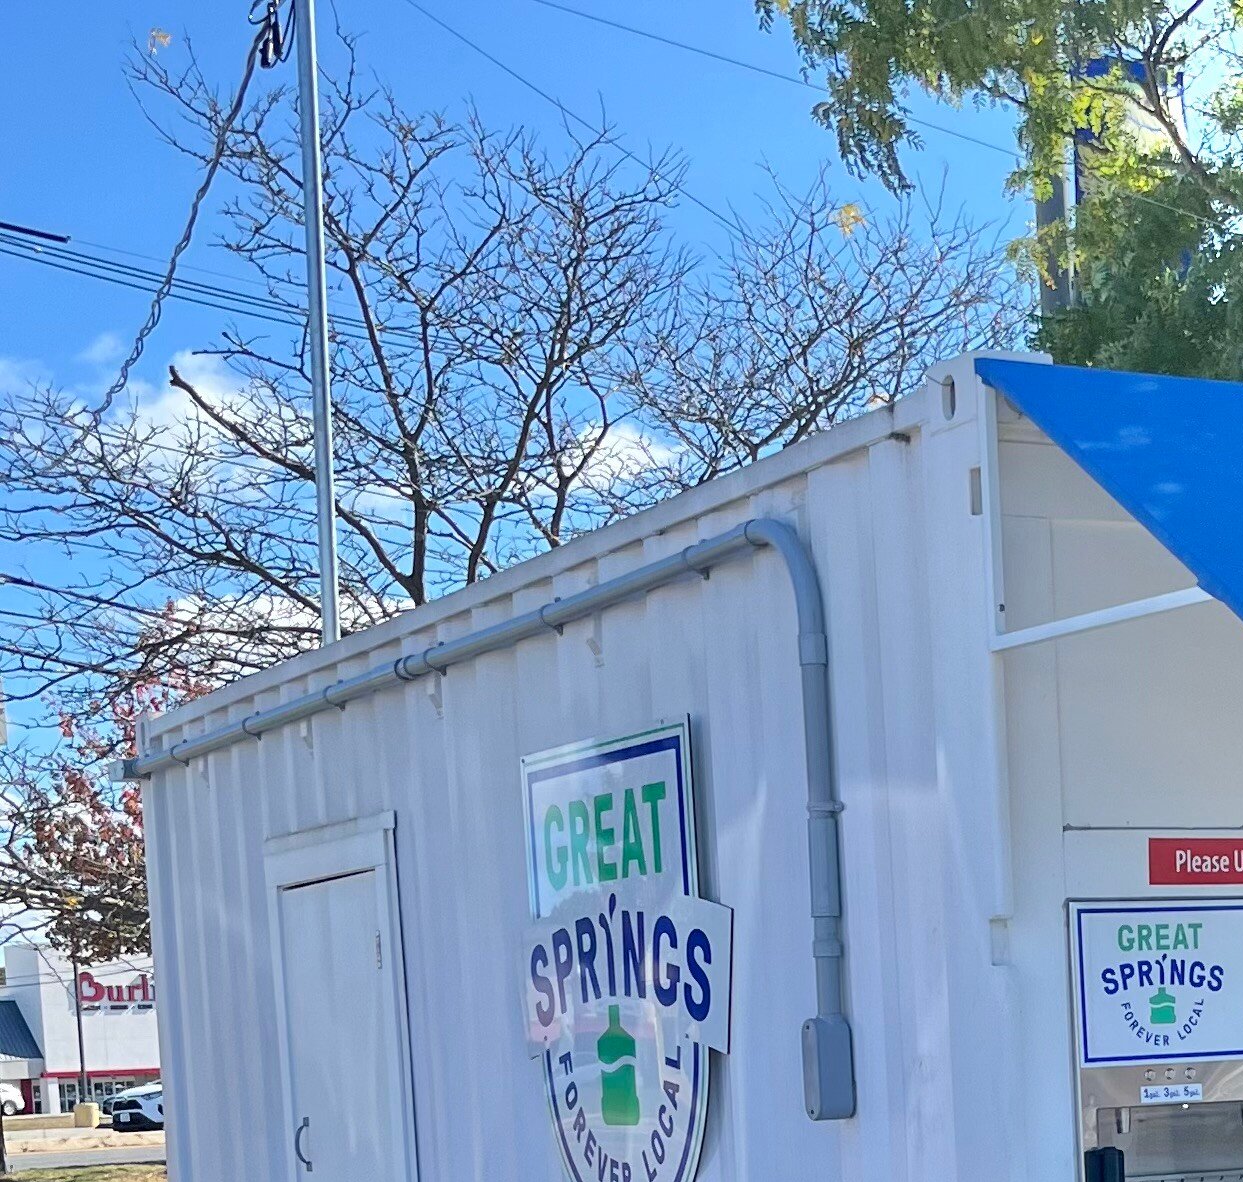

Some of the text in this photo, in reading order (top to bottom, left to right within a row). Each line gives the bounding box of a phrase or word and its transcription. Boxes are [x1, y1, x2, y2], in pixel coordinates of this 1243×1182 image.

[544, 781, 666, 891] GREAT
[1175, 849, 1230, 873] Please
[531, 893, 712, 1022] SPRINGS
[1117, 923, 1202, 951] GREAT
[78, 971, 156, 1002] Burl
[1101, 953, 1224, 995] SPRINGS
[1121, 999, 1204, 1046] FOREVER LOCAL
